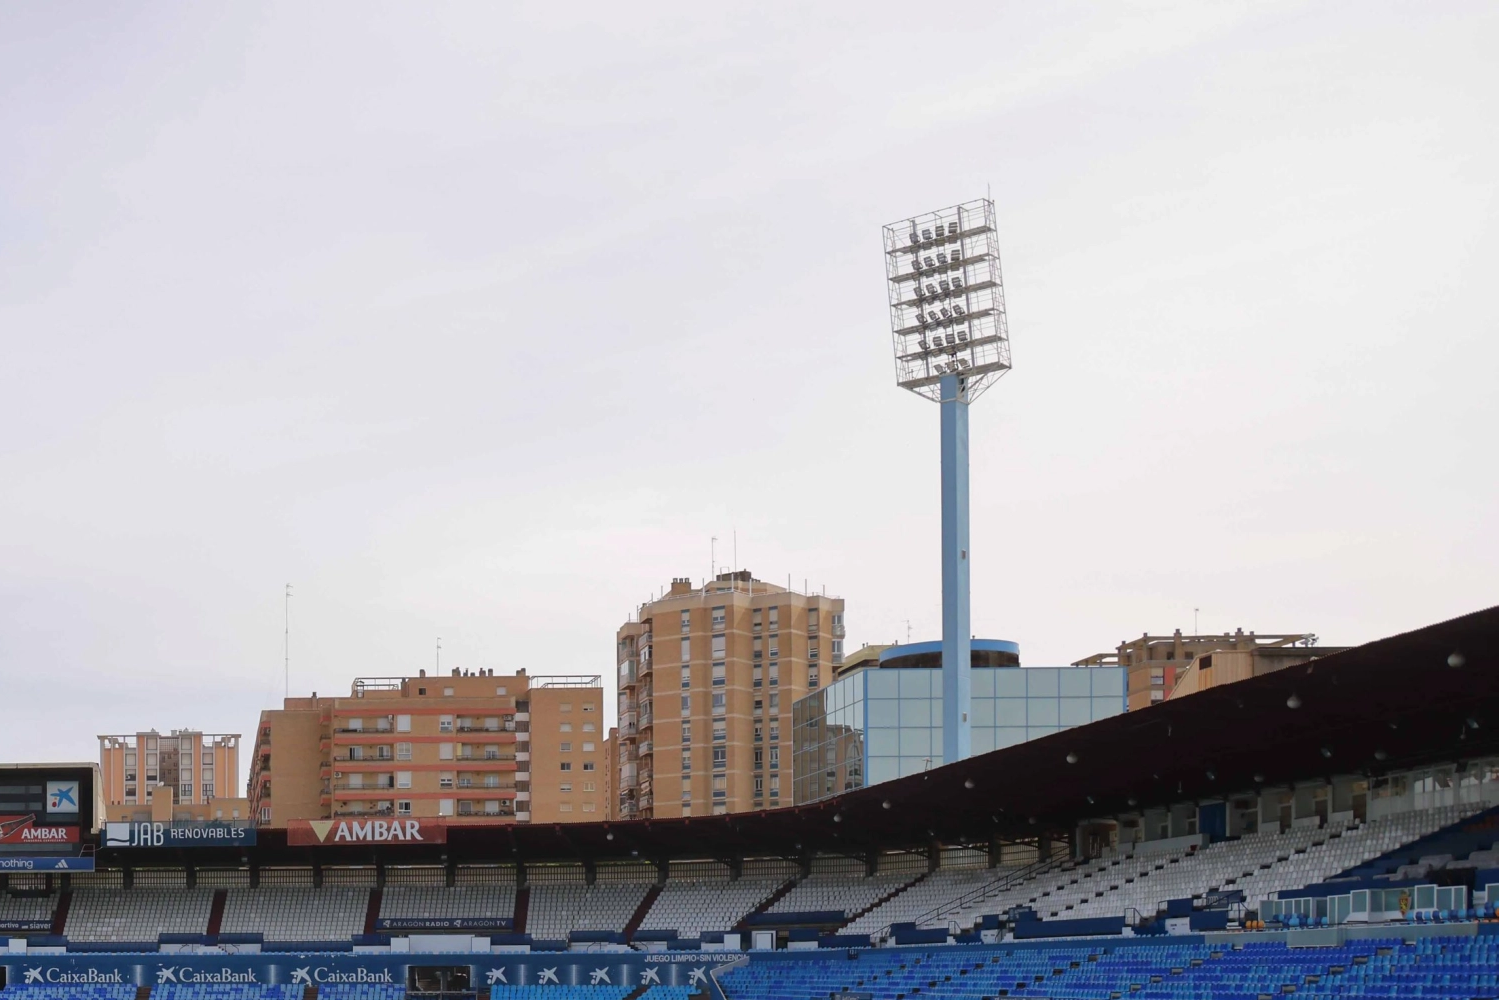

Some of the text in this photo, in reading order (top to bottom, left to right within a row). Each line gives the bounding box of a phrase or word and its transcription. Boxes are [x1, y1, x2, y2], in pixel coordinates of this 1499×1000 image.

[21, 828, 67, 839] AMBAR
[132, 823, 245, 846] JAB RENOVABLES
[334, 821, 423, 841] AMBAR
[46, 967, 123, 983] CaixaBank
[179, 967, 256, 983] CaixaBank
[314, 967, 393, 983] CaixaBank
